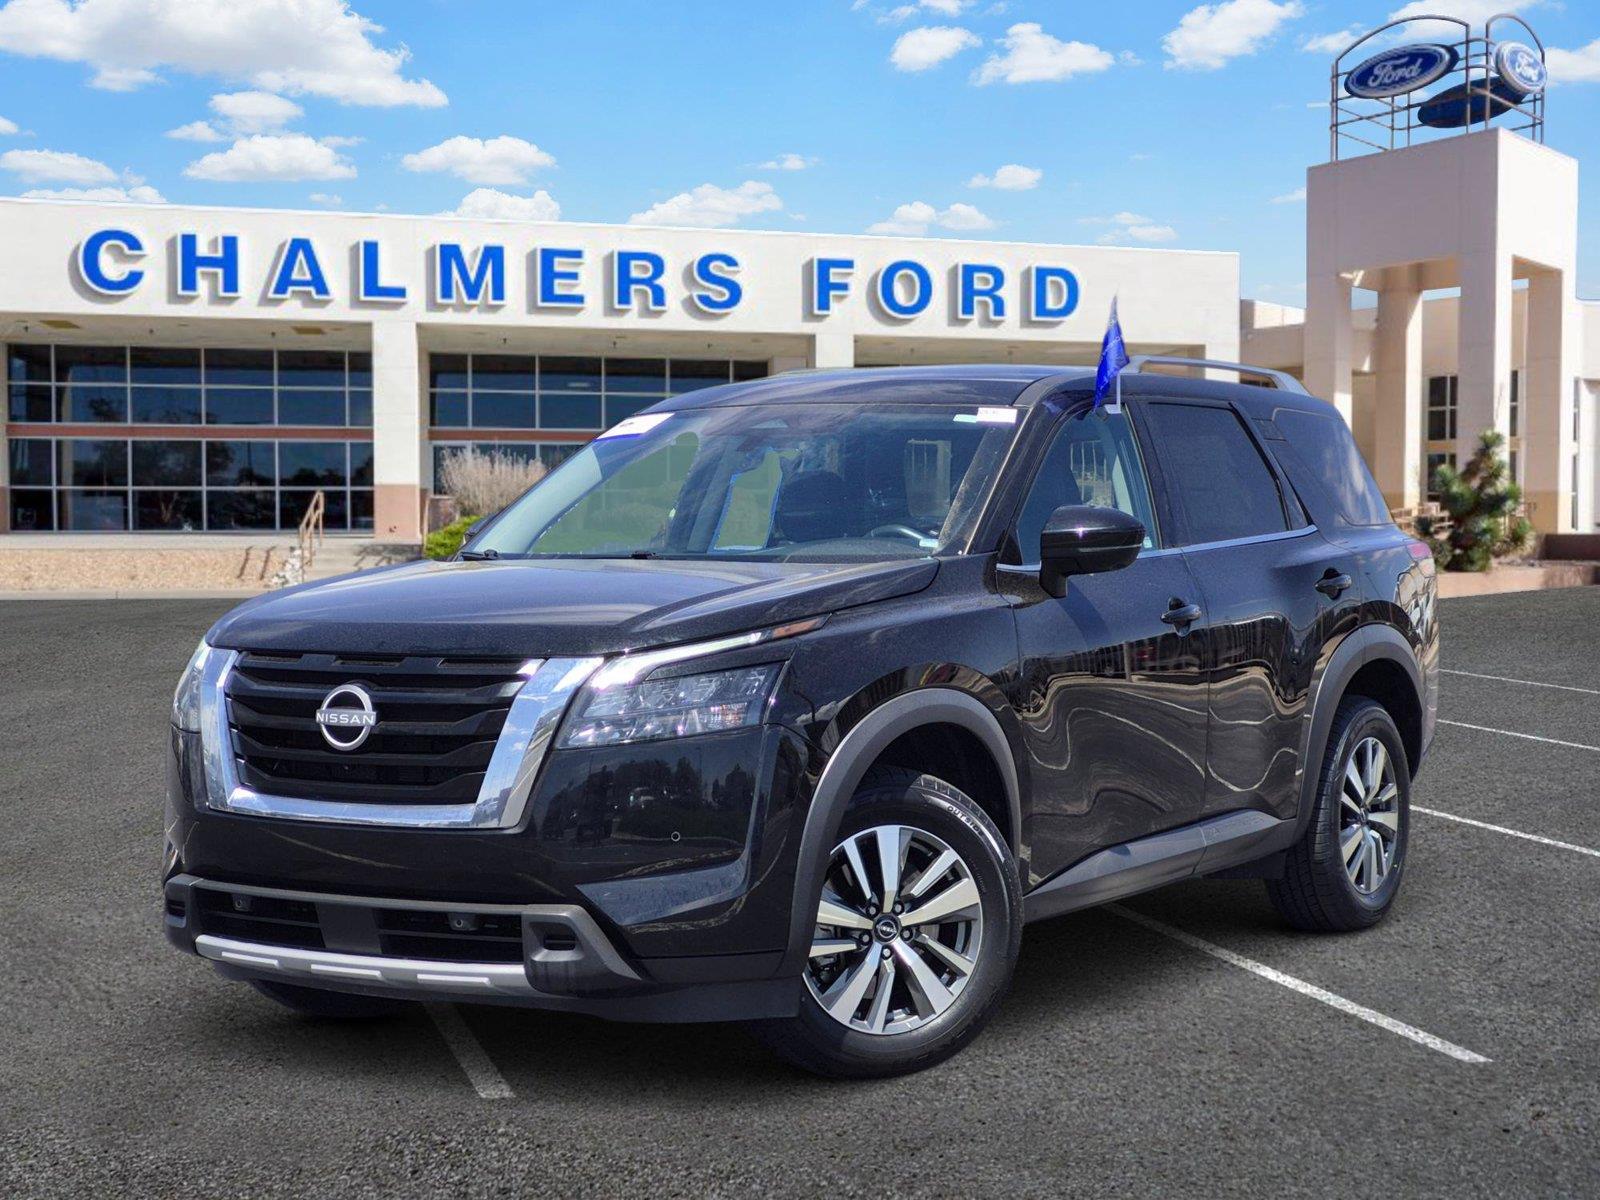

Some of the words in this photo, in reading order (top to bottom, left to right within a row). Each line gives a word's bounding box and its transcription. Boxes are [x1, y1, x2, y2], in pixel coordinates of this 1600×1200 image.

[1368, 56, 1423, 87] Ford
[80, 227, 742, 313] CHALMERS
[814, 258, 1081, 319] FORD
[316, 712, 374, 725] NISSAN
